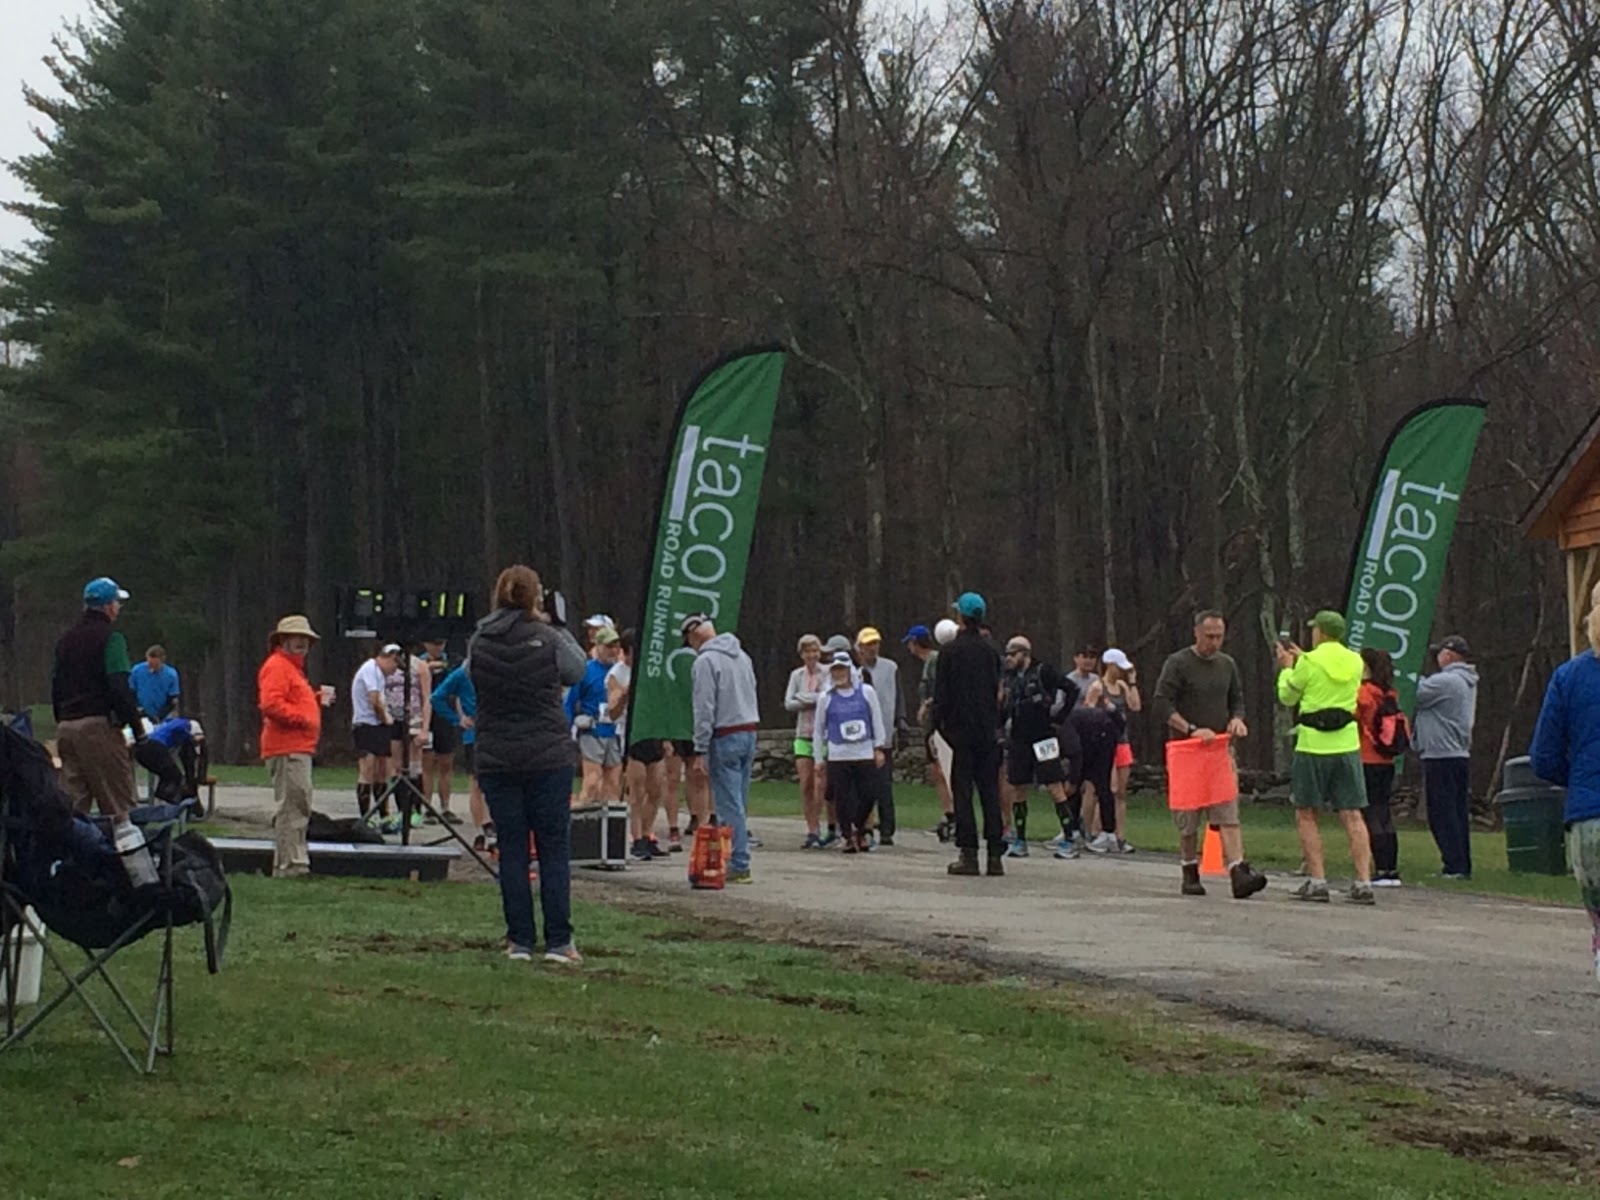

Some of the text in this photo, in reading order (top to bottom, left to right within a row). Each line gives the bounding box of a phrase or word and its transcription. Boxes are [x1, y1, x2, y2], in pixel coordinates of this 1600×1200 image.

[647, 522, 682, 678] ROAD RUNNERS
[1355, 560, 1378, 615] ROAD
[1371, 482, 1459, 682] tacon
